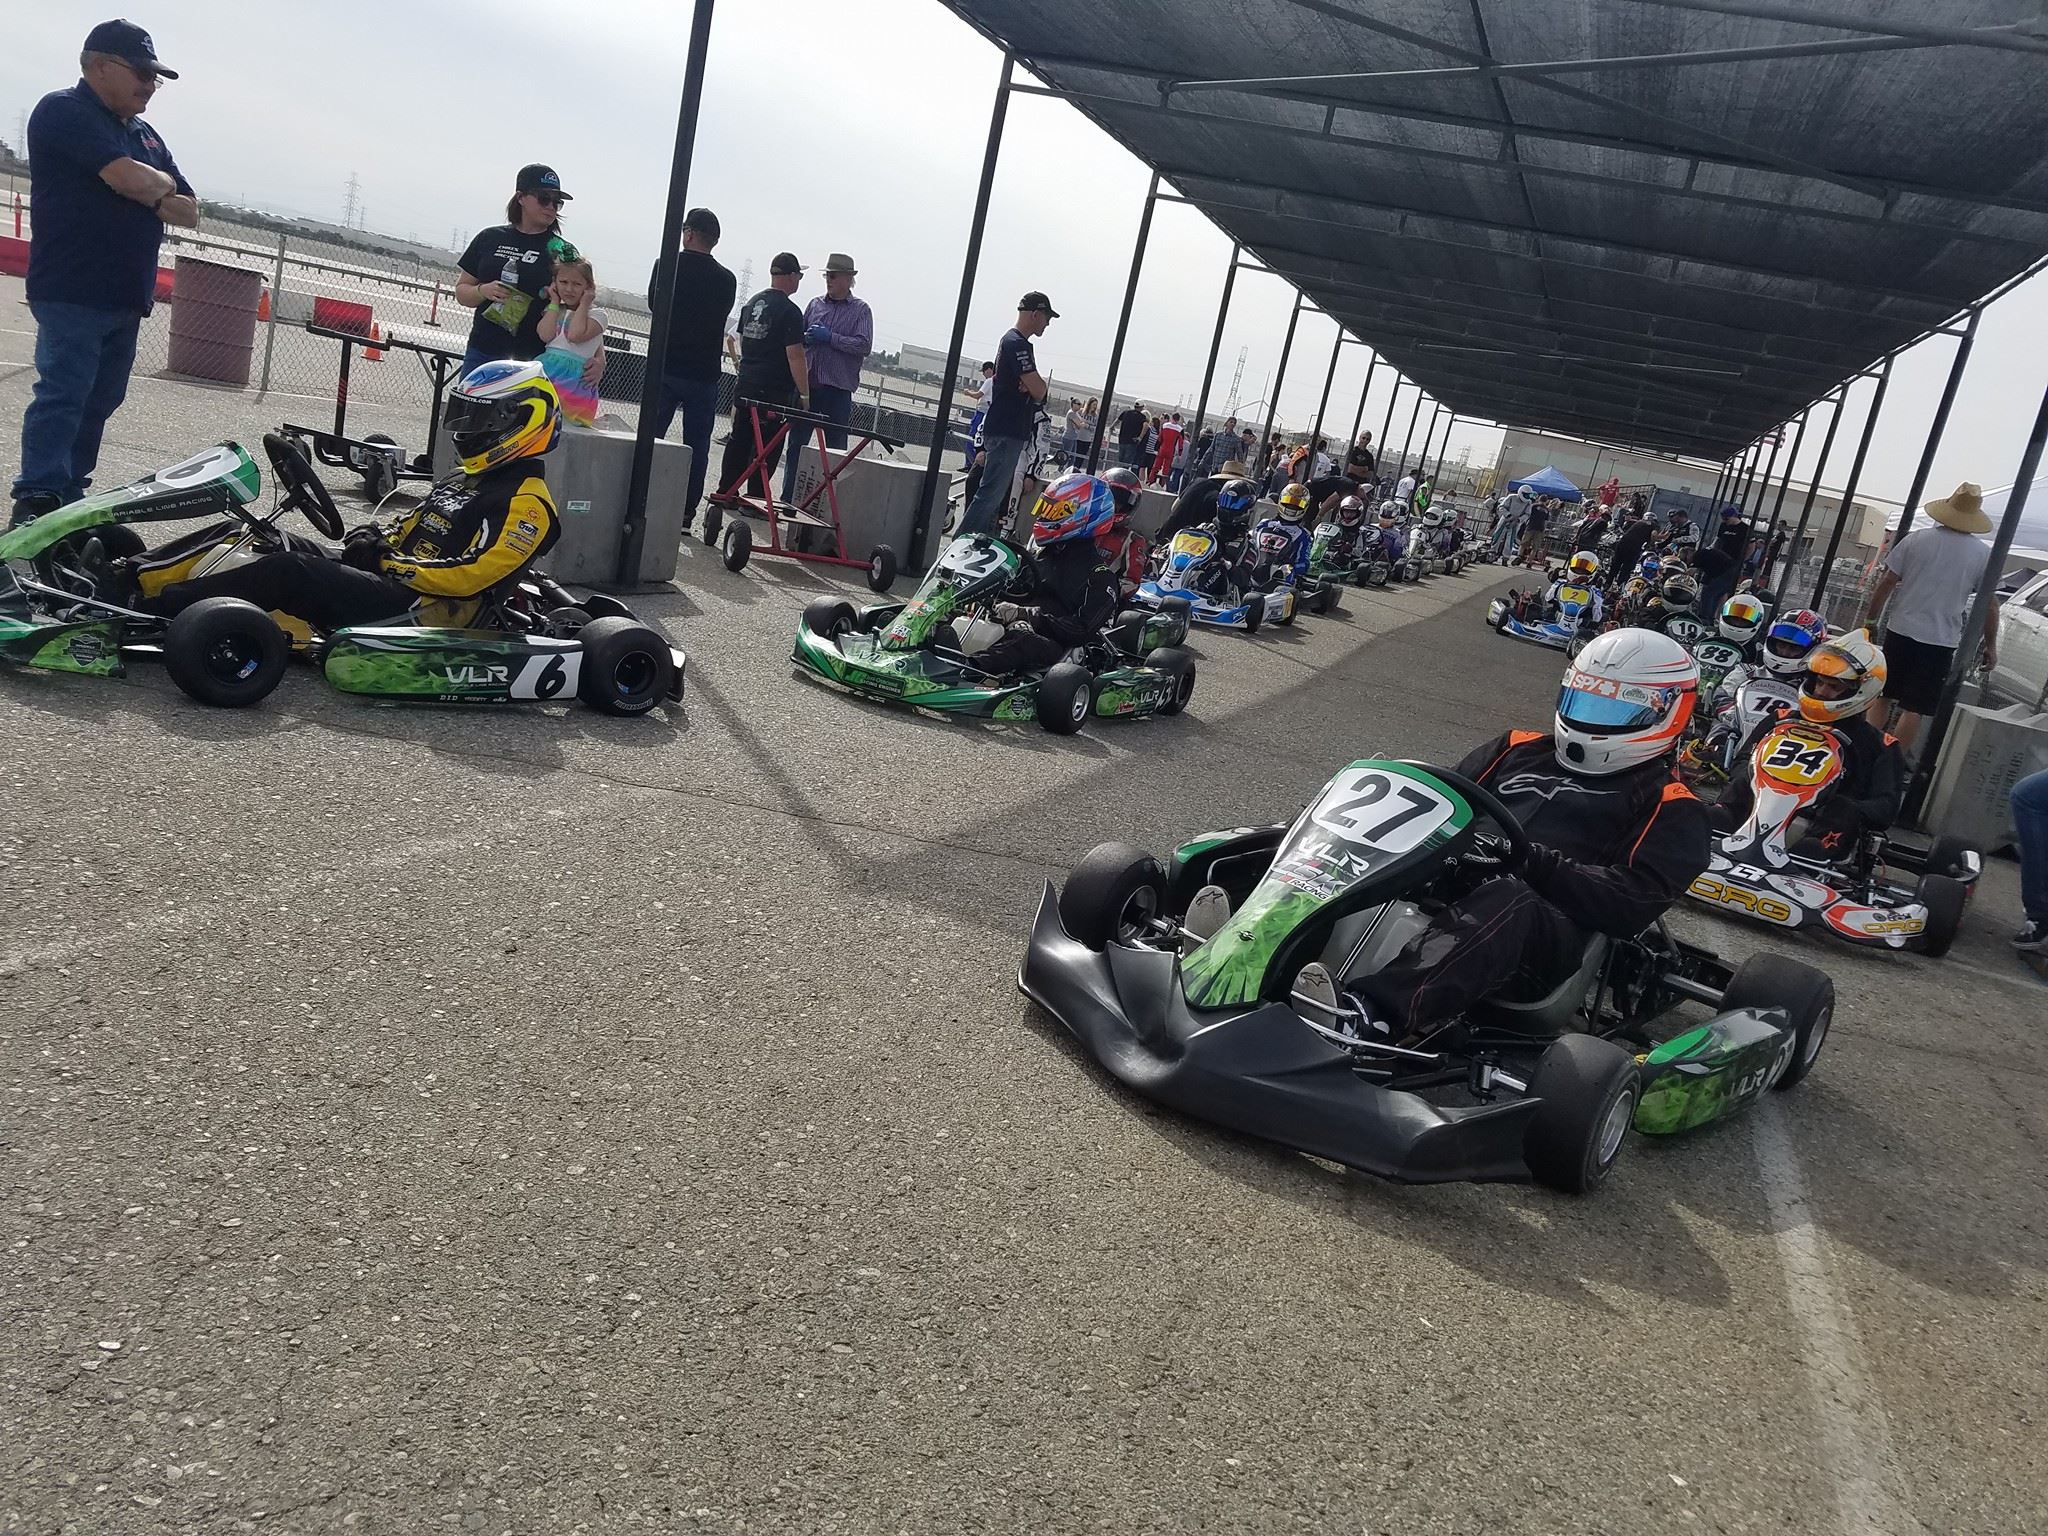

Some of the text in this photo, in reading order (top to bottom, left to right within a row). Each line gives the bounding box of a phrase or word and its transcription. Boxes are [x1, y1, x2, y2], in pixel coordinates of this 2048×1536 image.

[156, 503, 177, 512] LINE
[179, 496, 213, 507] RACING
[1700, 646, 1734, 663] 88
[445, 665, 509, 683] VLR
[534, 654, 567, 699] 6
[1753, 696, 1792, 716] 18
[1763, 739, 1833, 778] 34
[1318, 773, 1440, 844] 27
[1298, 837, 1370, 877] VLR
[1290, 879, 1334, 901] RACING
[1689, 878, 1791, 922] CRG
[1862, 918, 1922, 933] CRG
